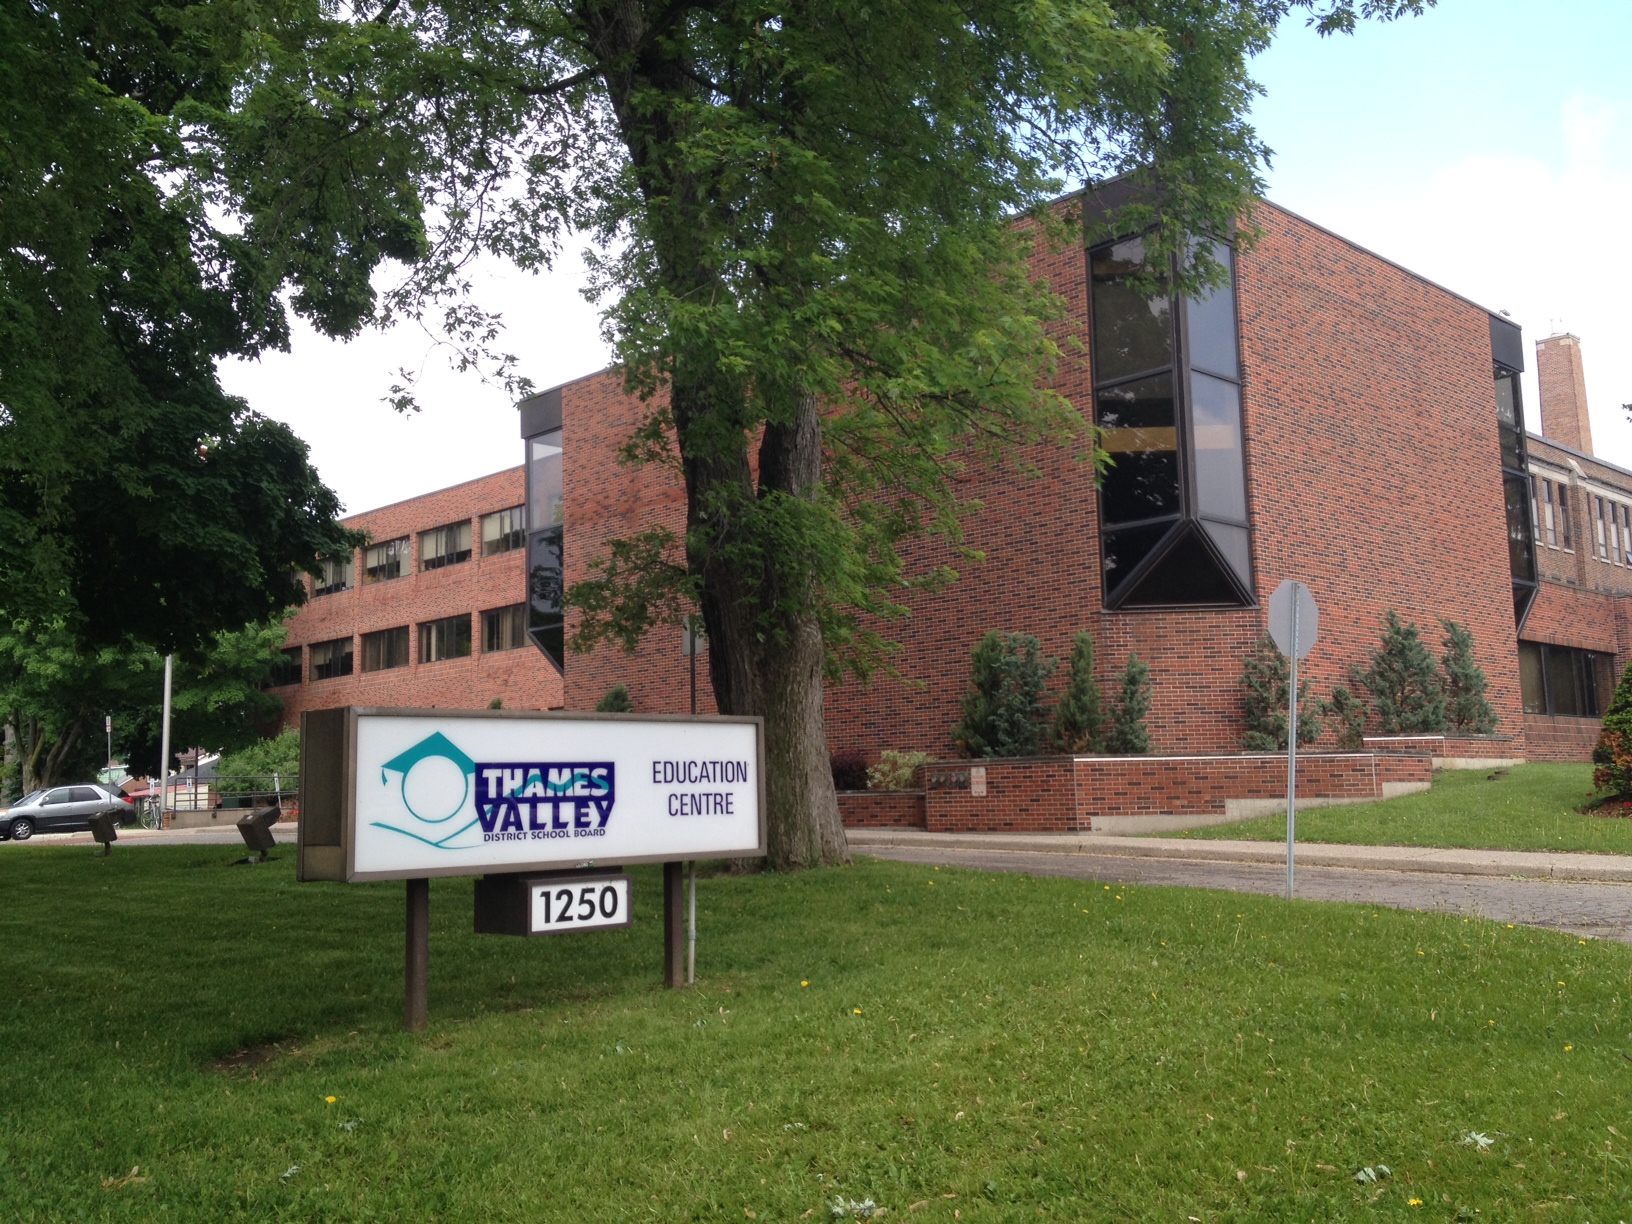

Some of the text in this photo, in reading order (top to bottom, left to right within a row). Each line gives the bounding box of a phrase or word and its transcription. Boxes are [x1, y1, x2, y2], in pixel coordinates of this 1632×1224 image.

[482, 767, 610, 798] THAMES
[652, 760, 747, 784] EDUCATION
[476, 801, 615, 832] VALLEY
[668, 793, 734, 816] CENTRE
[483, 828, 606, 842] DISTRICT SCHOOL BOARD
[540, 886, 618, 924] 1250
